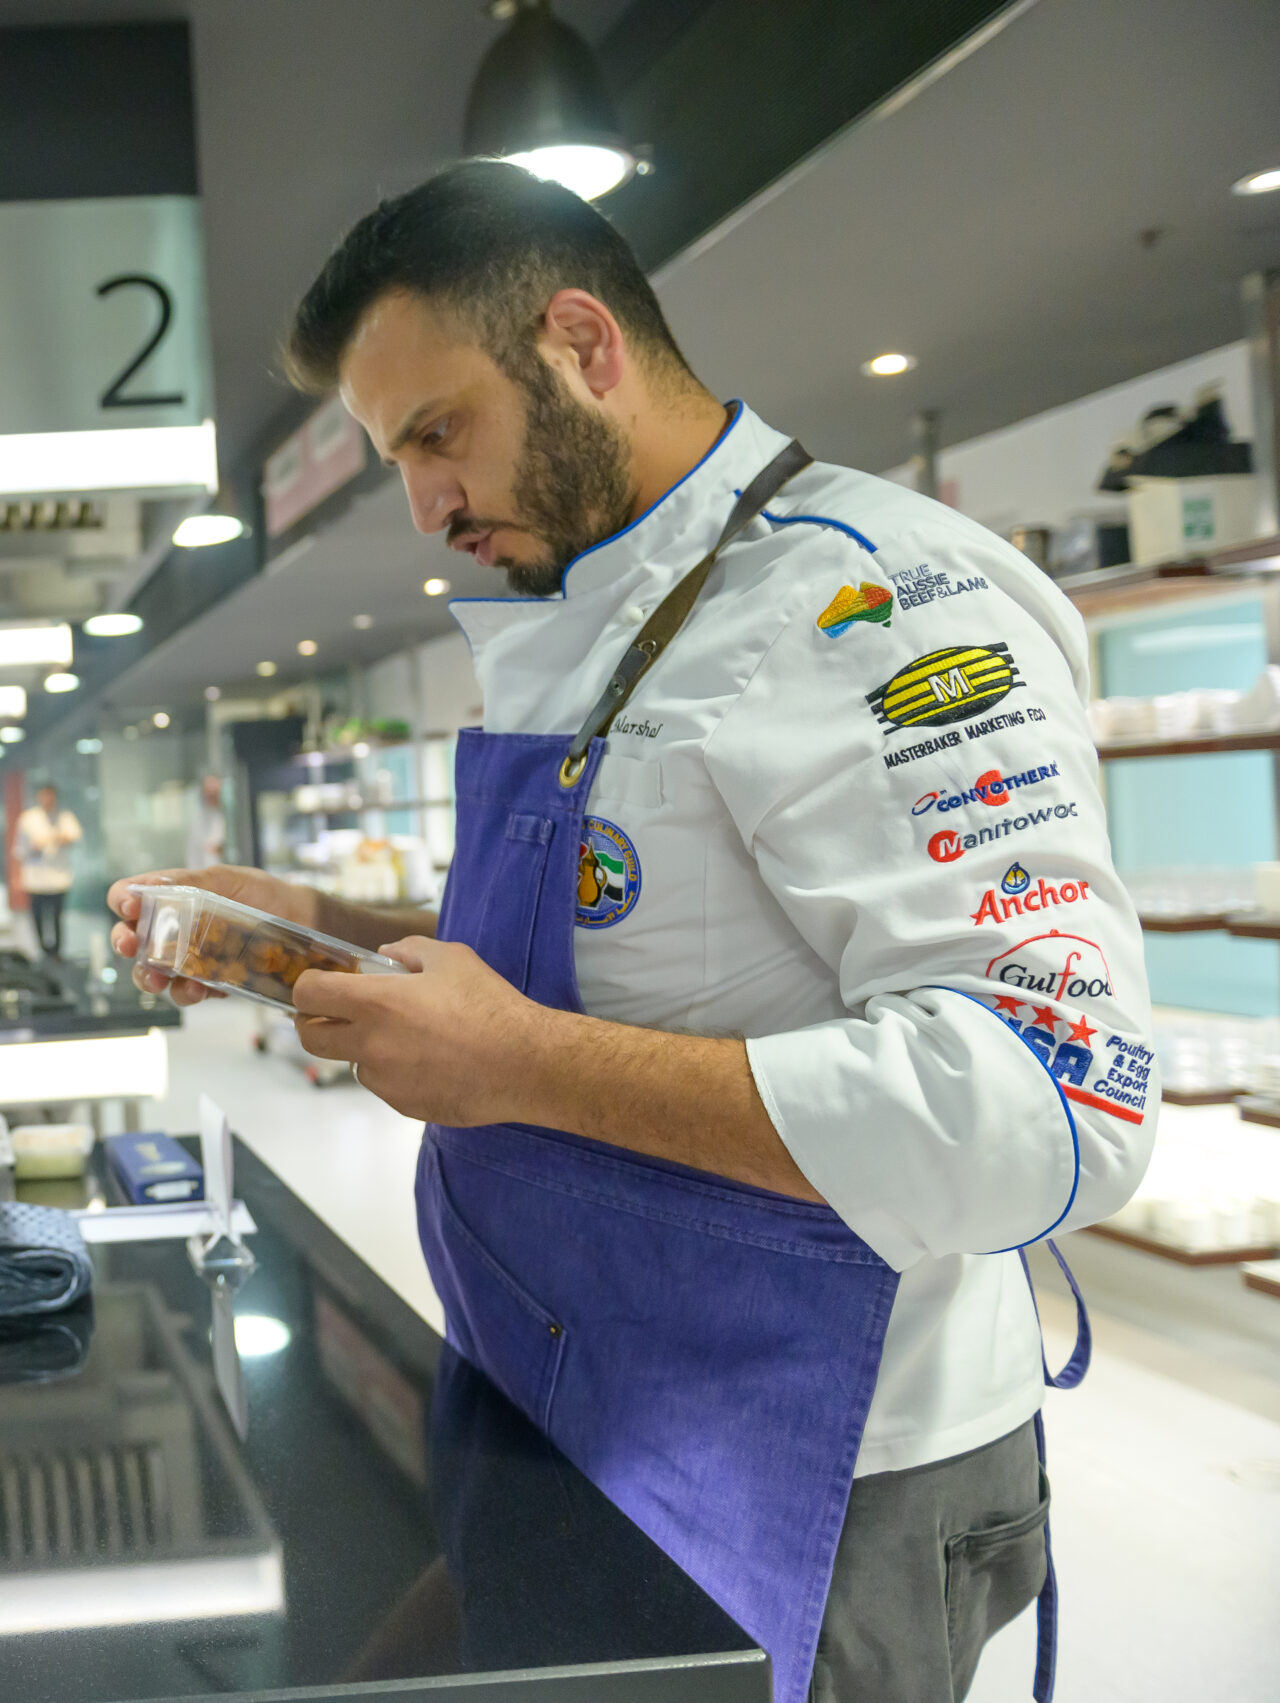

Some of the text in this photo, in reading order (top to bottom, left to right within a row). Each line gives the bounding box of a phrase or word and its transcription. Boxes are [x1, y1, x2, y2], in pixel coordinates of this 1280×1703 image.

[97, 273, 183, 408] 2
[888, 563, 931, 586] TRUE
[896, 572, 950, 599] AUSSIE
[928, 667, 971, 703] M
[883, 731, 963, 770] MASTERBAKER
[964, 711, 1026, 740] MARKETING
[588, 819, 638, 881] CULINARY GUILD
[970, 878, 1089, 926] Anchor
[1002, 1014, 1094, 1087] SA
[1105, 1034, 1155, 1066] Poultry
[1112, 1053, 1151, 1081] & Egg
[1093, 1079, 1147, 1110] Council
[1106, 1067, 1148, 1094] Export
